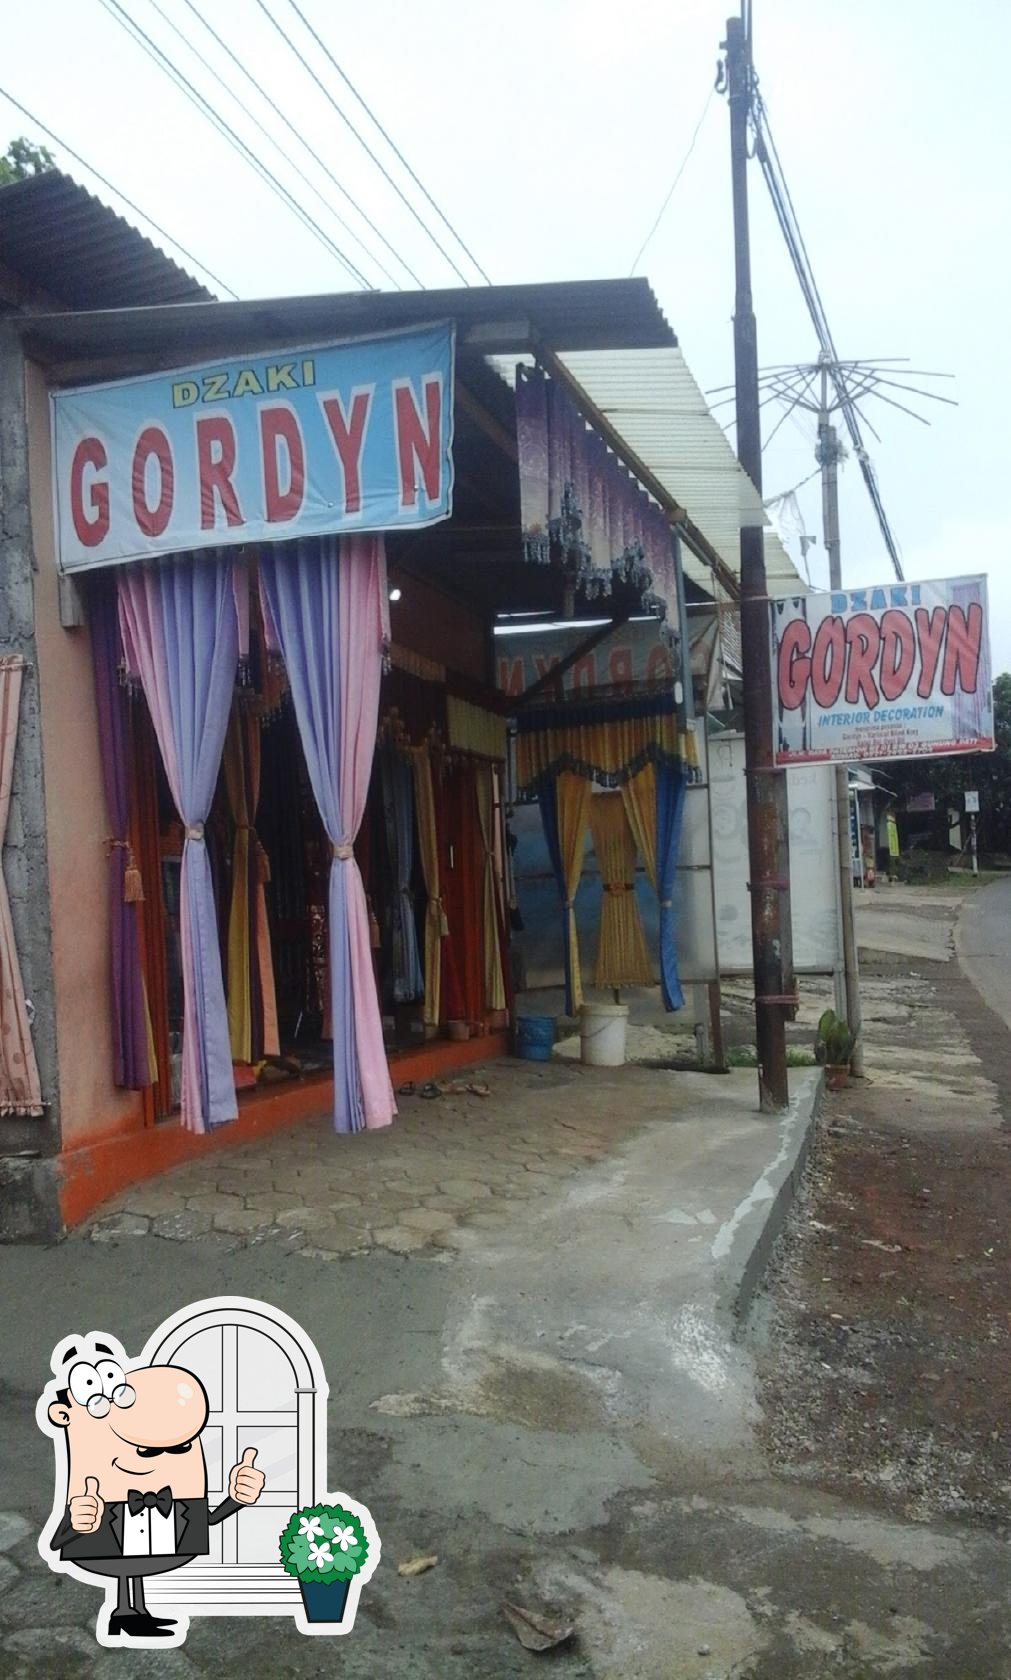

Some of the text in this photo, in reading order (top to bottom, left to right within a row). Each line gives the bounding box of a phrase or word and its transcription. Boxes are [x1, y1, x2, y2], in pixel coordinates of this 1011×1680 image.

[172, 359, 317, 408] DZAKI
[71, 381, 442, 547] GORDYN
[778, 602, 983, 711] GORDYN
[818, 705, 945, 727] INTERIOR DECORATION
